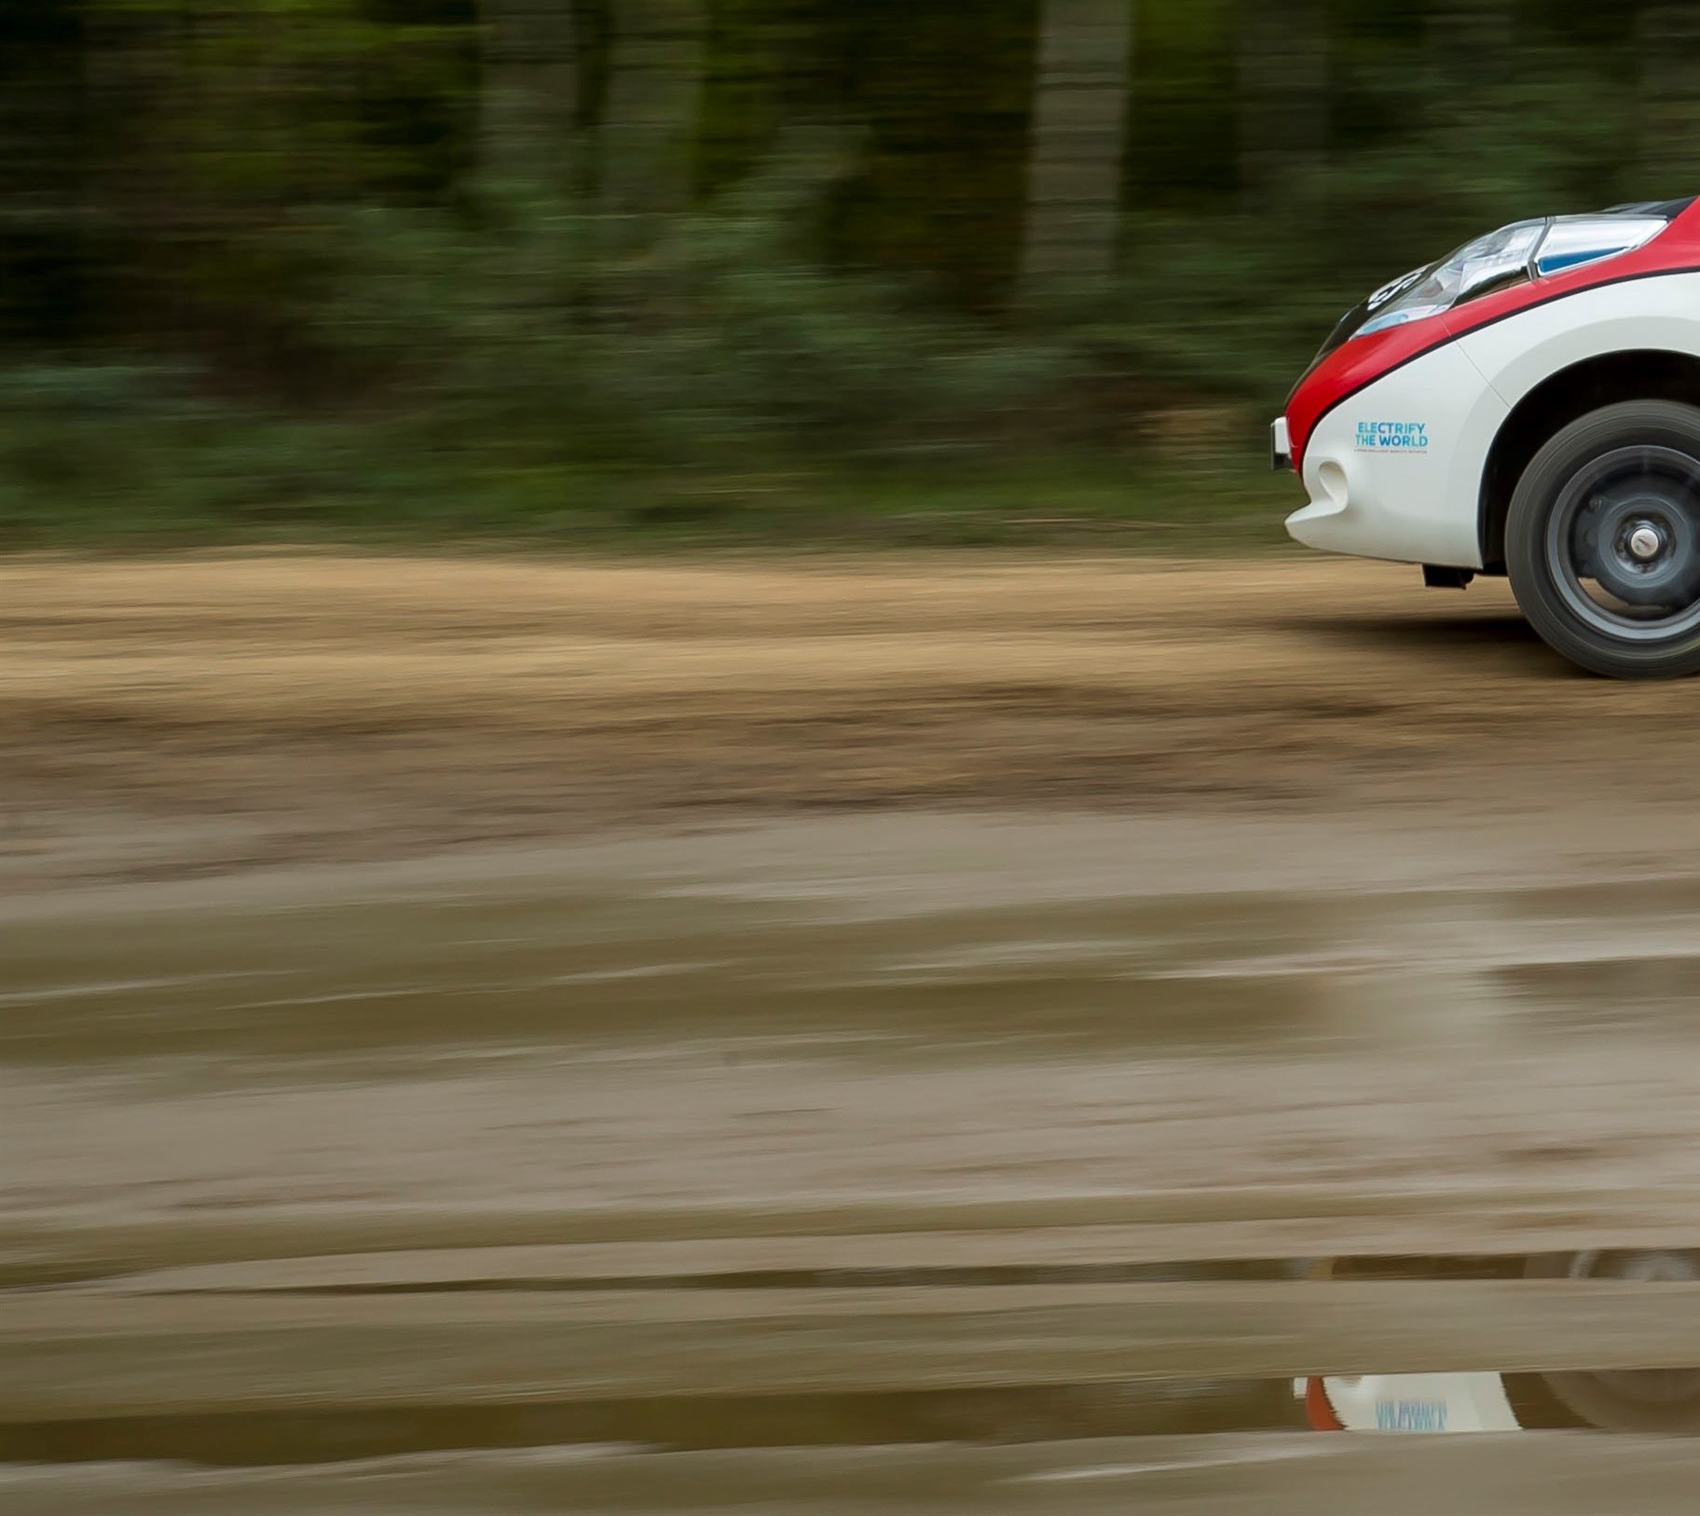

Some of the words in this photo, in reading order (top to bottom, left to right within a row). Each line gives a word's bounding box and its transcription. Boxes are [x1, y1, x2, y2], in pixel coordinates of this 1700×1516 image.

[1358, 422, 1426, 434] ELECTRIFY
[1355, 434, 1376, 446] THE
[1379, 435, 1428, 447] WORLD
